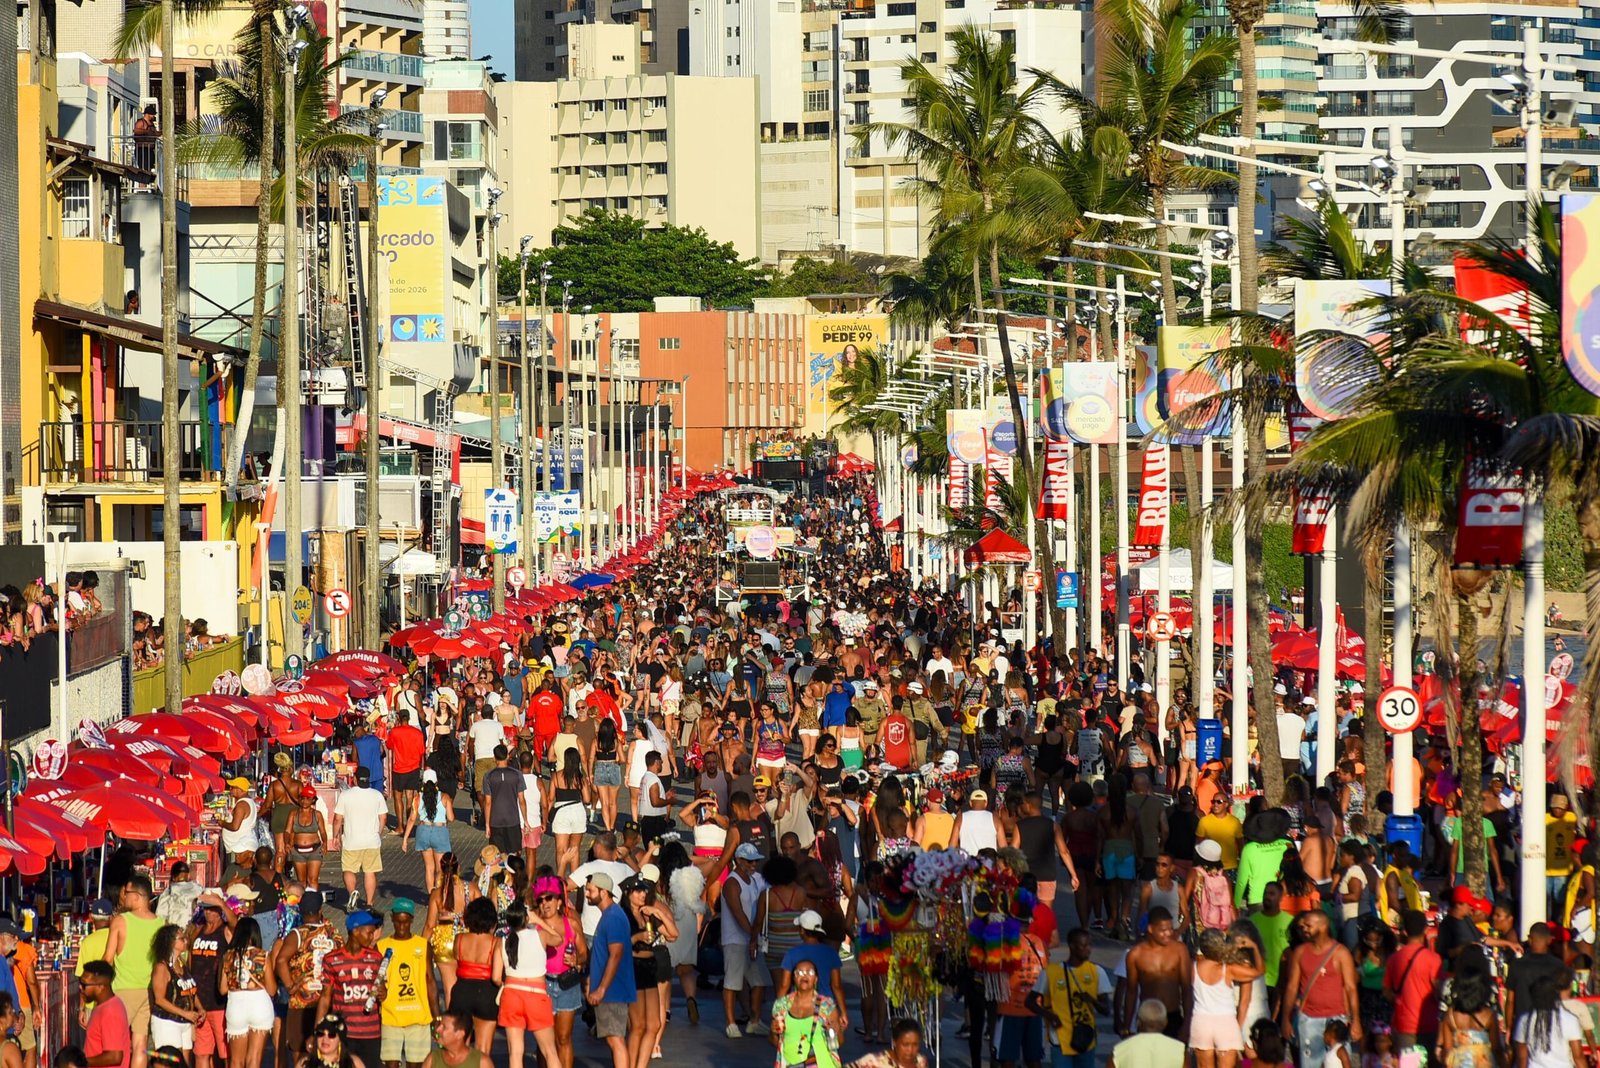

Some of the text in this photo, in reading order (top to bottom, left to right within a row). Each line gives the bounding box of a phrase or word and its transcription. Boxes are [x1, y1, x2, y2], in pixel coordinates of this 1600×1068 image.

[187, 44, 236, 57] O CAR
[407, 286, 428, 294] 2026
[831, 324, 872, 332] CARNAVAL
[823, 332, 872, 343] PEDE 99
[1385, 697, 1416, 718] 30
[193, 937, 218, 950] Bora
[342, 982, 369, 1000] bs2
[398, 982, 416, 997] Zé
